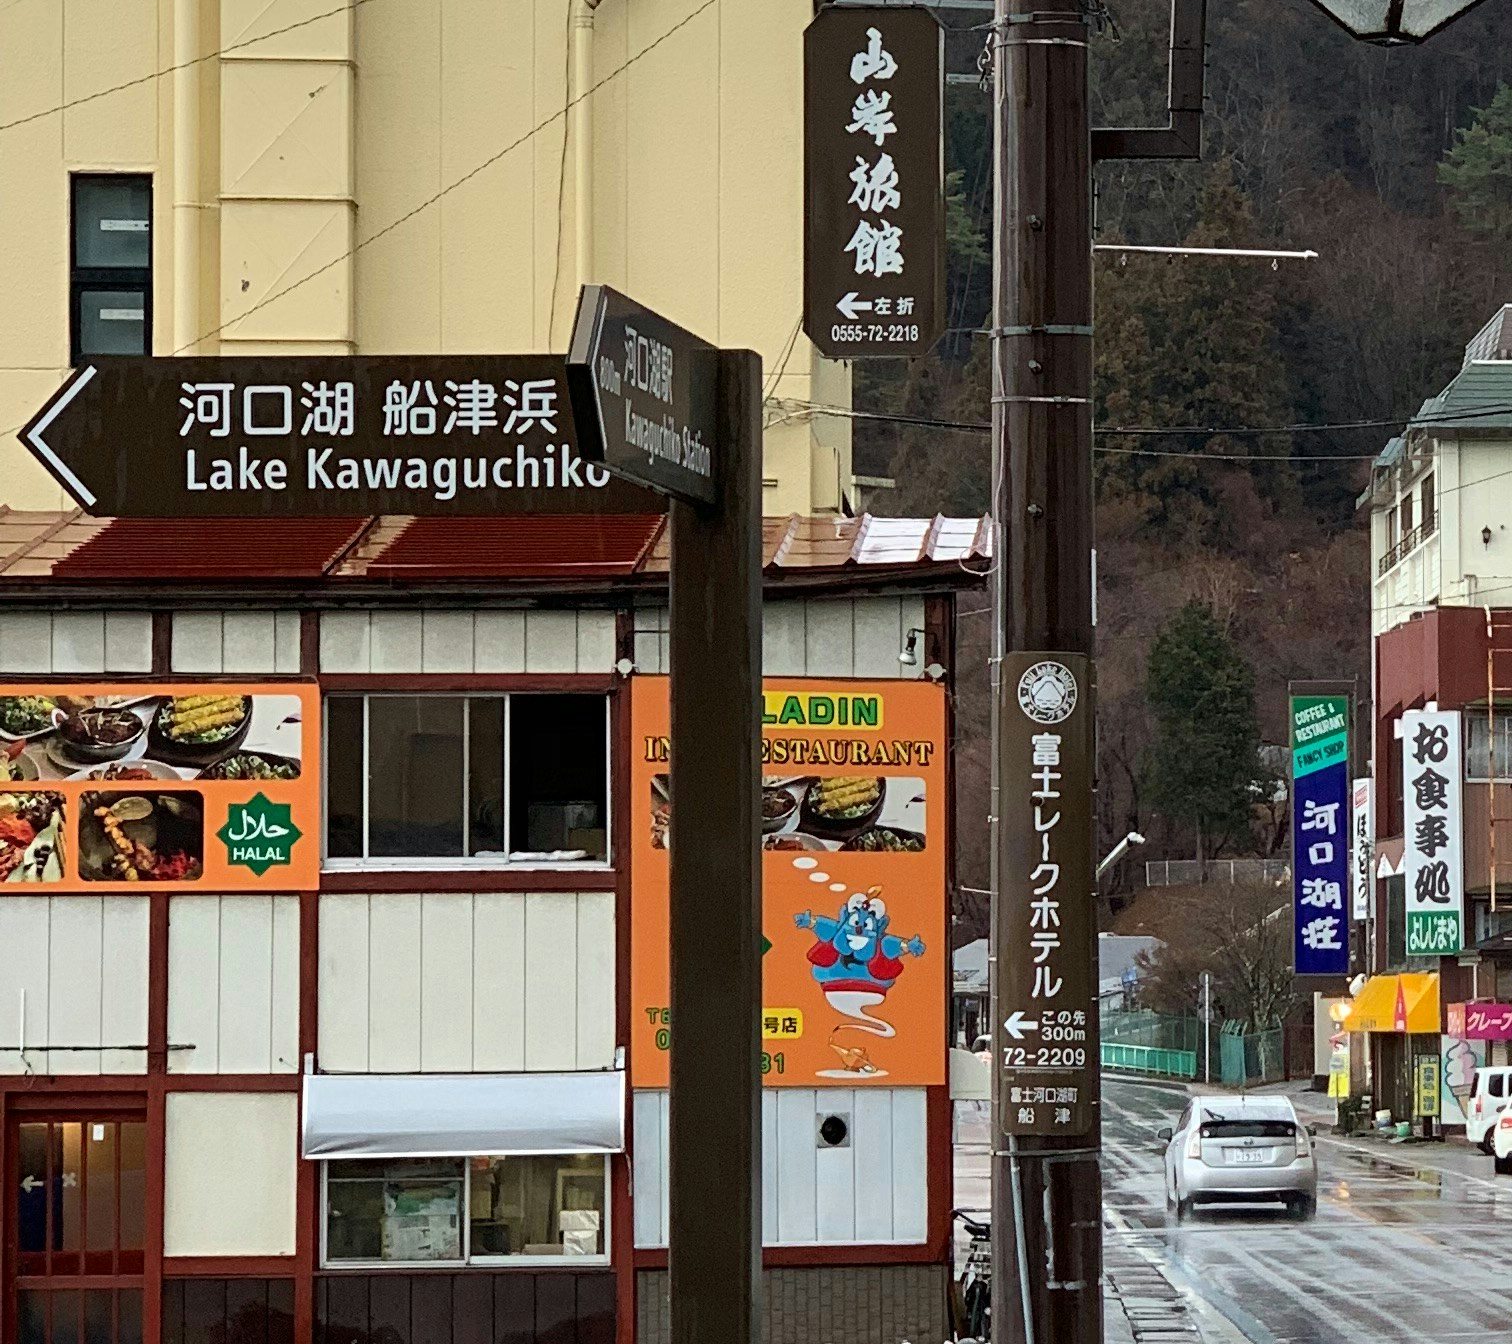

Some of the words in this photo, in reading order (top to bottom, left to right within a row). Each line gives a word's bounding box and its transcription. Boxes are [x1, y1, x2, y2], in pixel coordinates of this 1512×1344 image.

[845, 27, 904, 278] 山岸旅館
[874, 297, 915, 316] 左折
[831, 324, 919, 343] 0555-72-2218
[179, 380, 354, 437] 河口湖
[383, 379, 558, 435] 船津浜
[186, 447, 288, 490] Lake
[307, 444, 610, 500] Kawaguchiko
[1295, 704, 1327, 725] COFFEE
[1295, 713, 1345, 742] RESTAURANT
[228, 808, 290, 841] حلال
[1412, 722, 1451, 904] お食事処
[233, 846, 286, 861] HALAL
[1029, 732, 1063, 998] 富士レークホテル
[1301, 799, 1342, 950] 河口湖荘
[1041, 1010, 1086, 1026] この先
[1041, 1027, 1086, 1041] 300m
[1003, 1047, 1086, 1066] 72-2209
[1017, 1107, 1071, 1124] 船津
